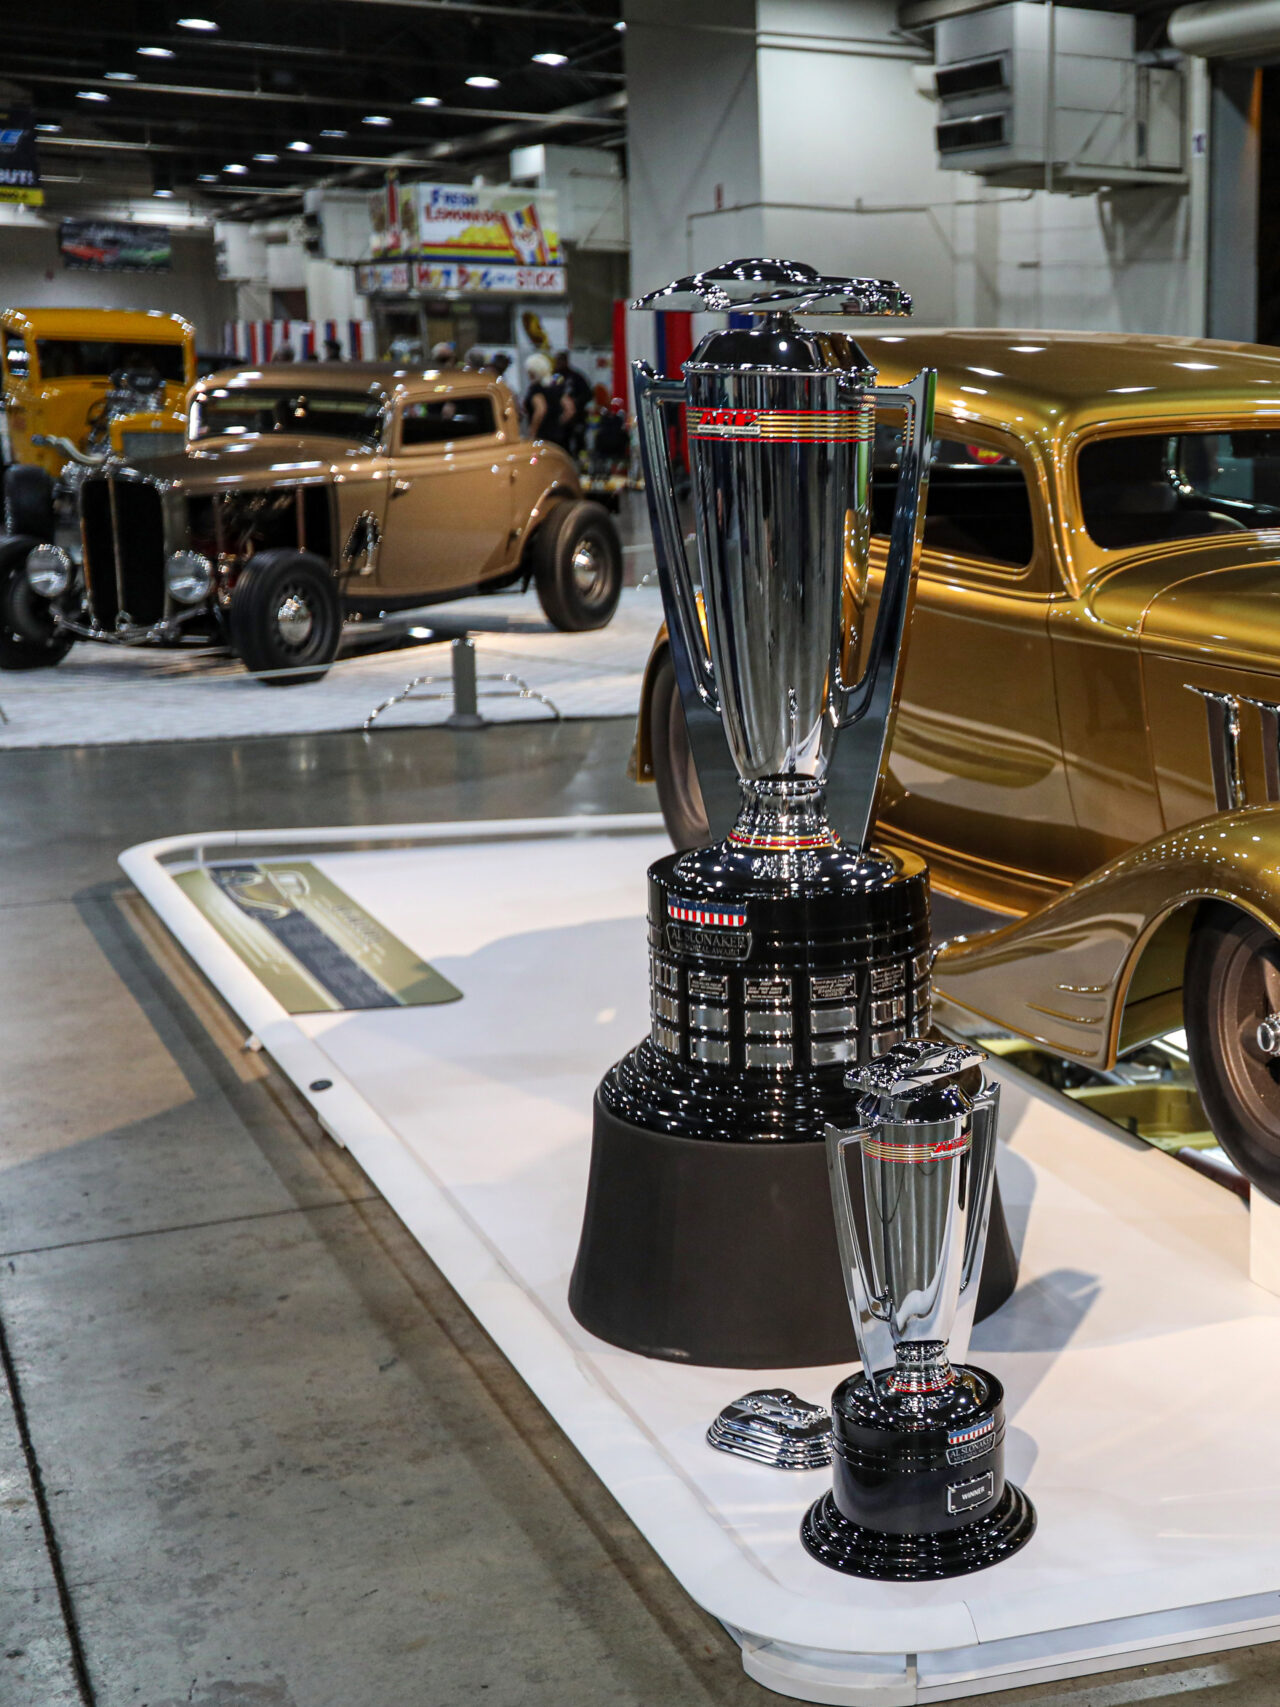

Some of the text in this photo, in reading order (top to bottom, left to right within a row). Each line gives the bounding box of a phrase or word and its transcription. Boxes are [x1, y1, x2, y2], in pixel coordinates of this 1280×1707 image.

[417, 264, 452, 288] HOT
[516, 269, 560, 288] STICK
[698, 411, 758, 426] ARP
[671, 929, 745, 949] AL SLONAKER
[962, 1486, 985, 1500] WINNER
